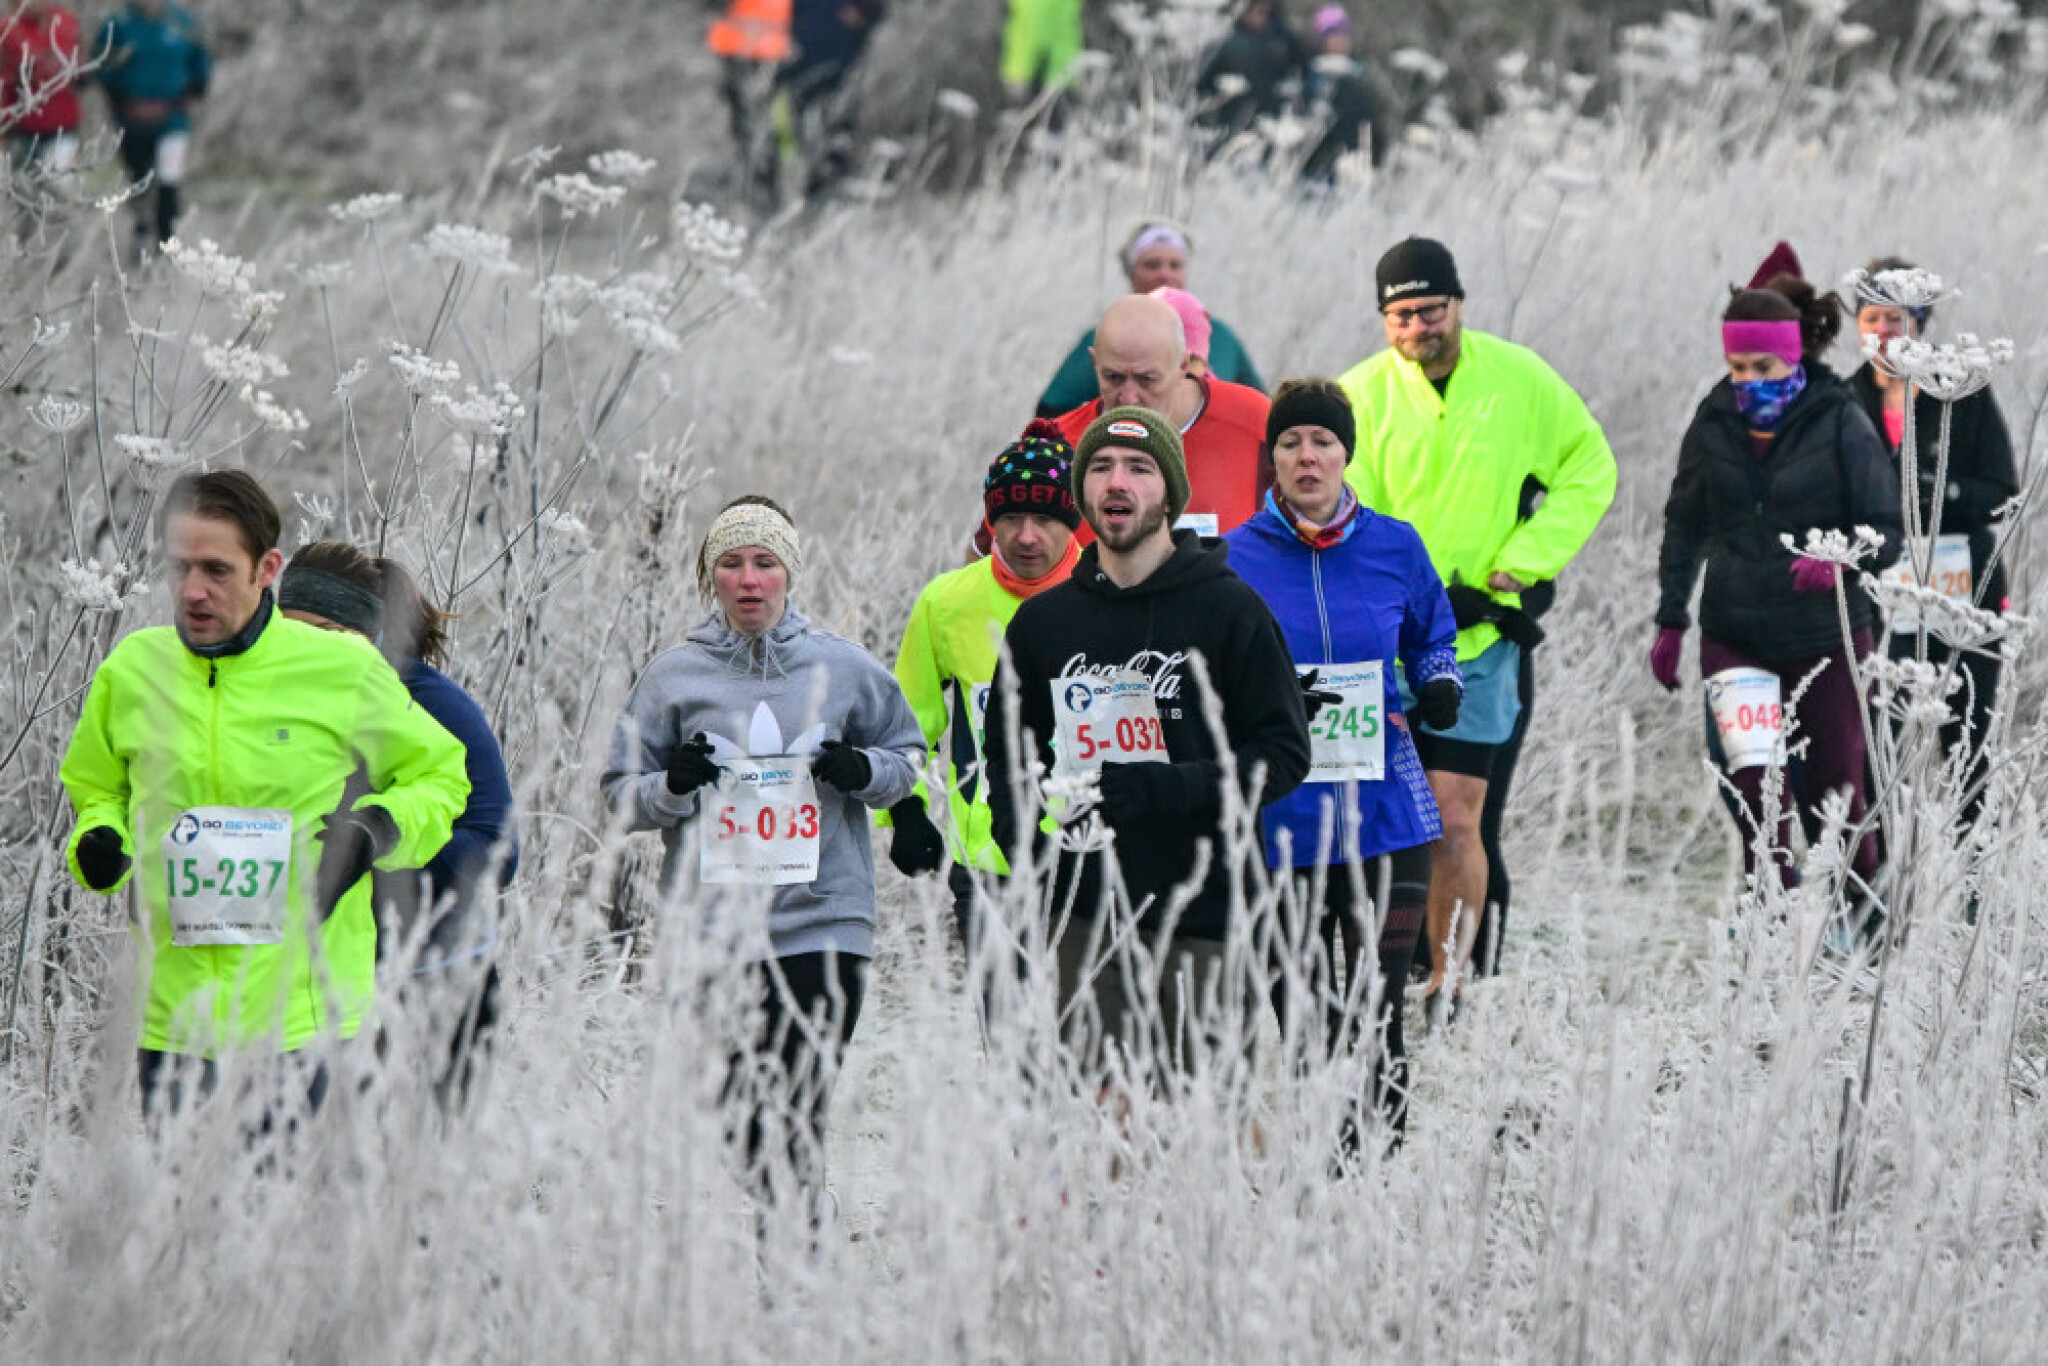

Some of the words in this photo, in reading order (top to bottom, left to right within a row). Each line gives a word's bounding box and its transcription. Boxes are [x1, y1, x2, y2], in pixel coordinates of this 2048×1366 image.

[1011, 484, 1057, 504] GET
[1060, 649, 1191, 699] Coca-Cla
[1077, 716, 1168, 760] 5-032
[718, 804, 819, 840] 5-033
[168, 857, 285, 898] 15-237
